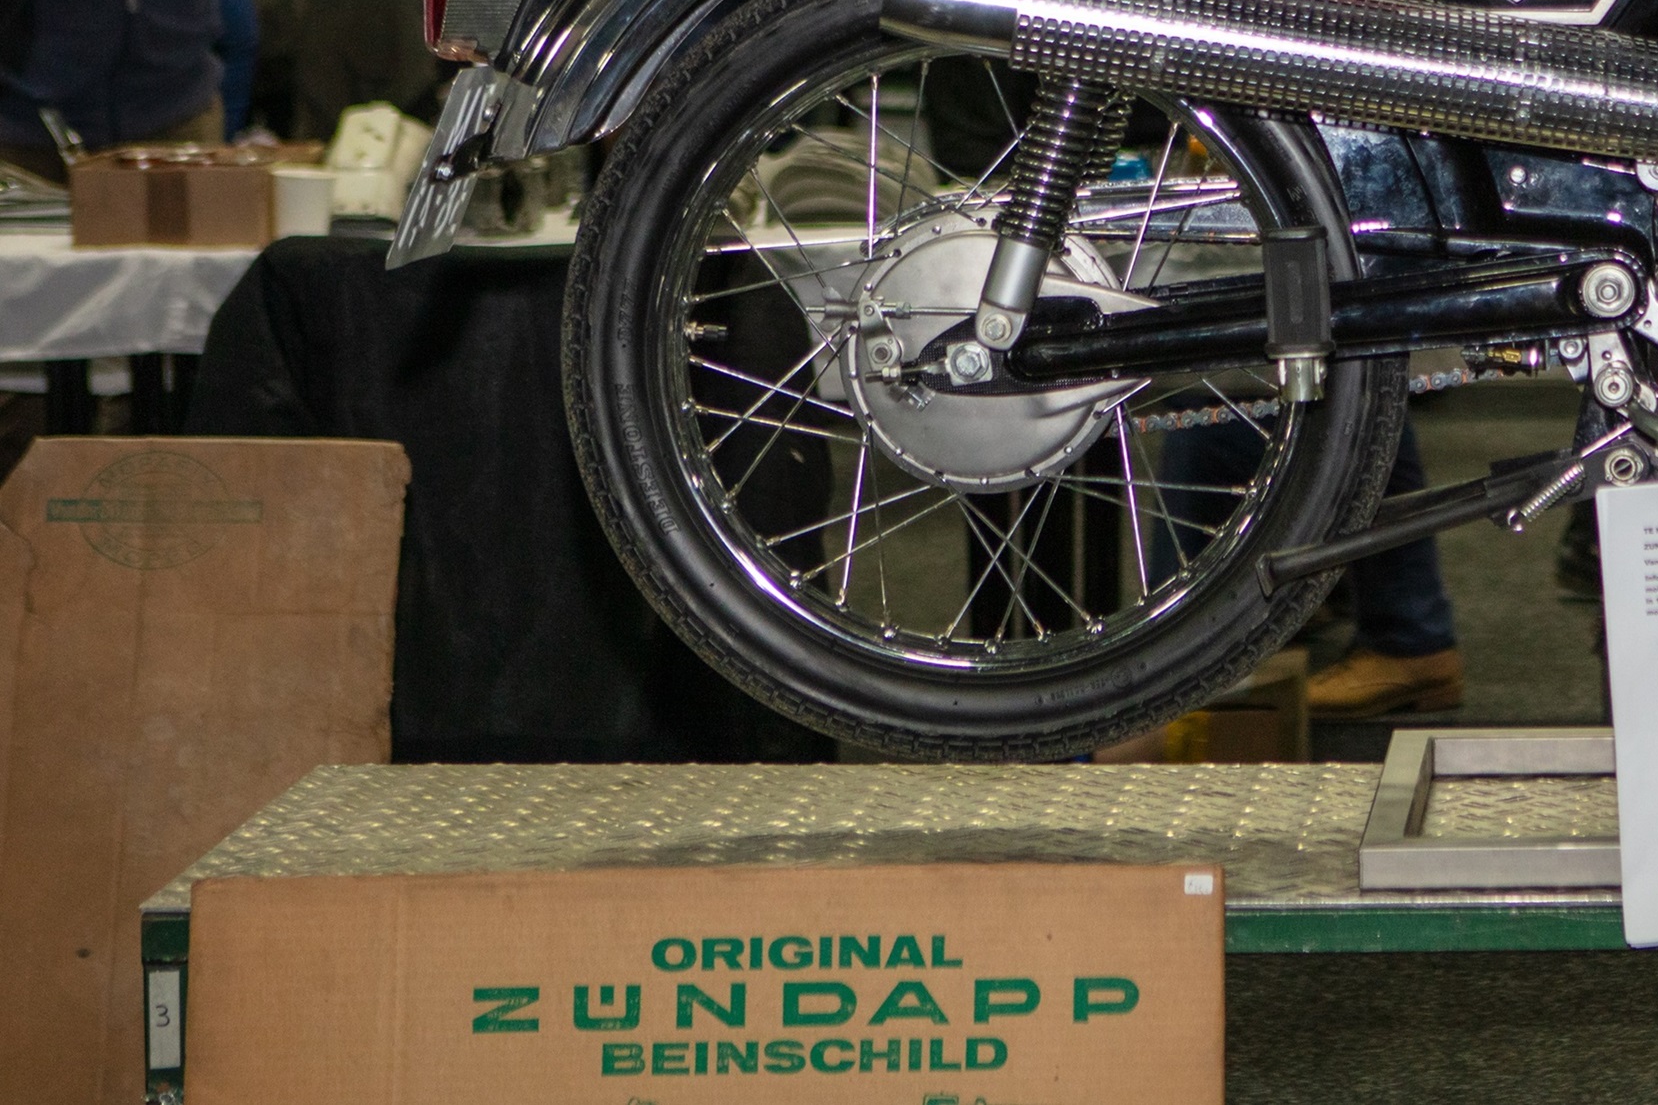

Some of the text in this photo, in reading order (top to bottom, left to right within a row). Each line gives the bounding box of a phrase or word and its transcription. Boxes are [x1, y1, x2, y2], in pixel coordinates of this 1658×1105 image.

[651, 935, 963, 971] ORIGINAL
[155, 1002, 171, 1028] 3
[601, 1037, 1008, 1077] BEINSCHILD
